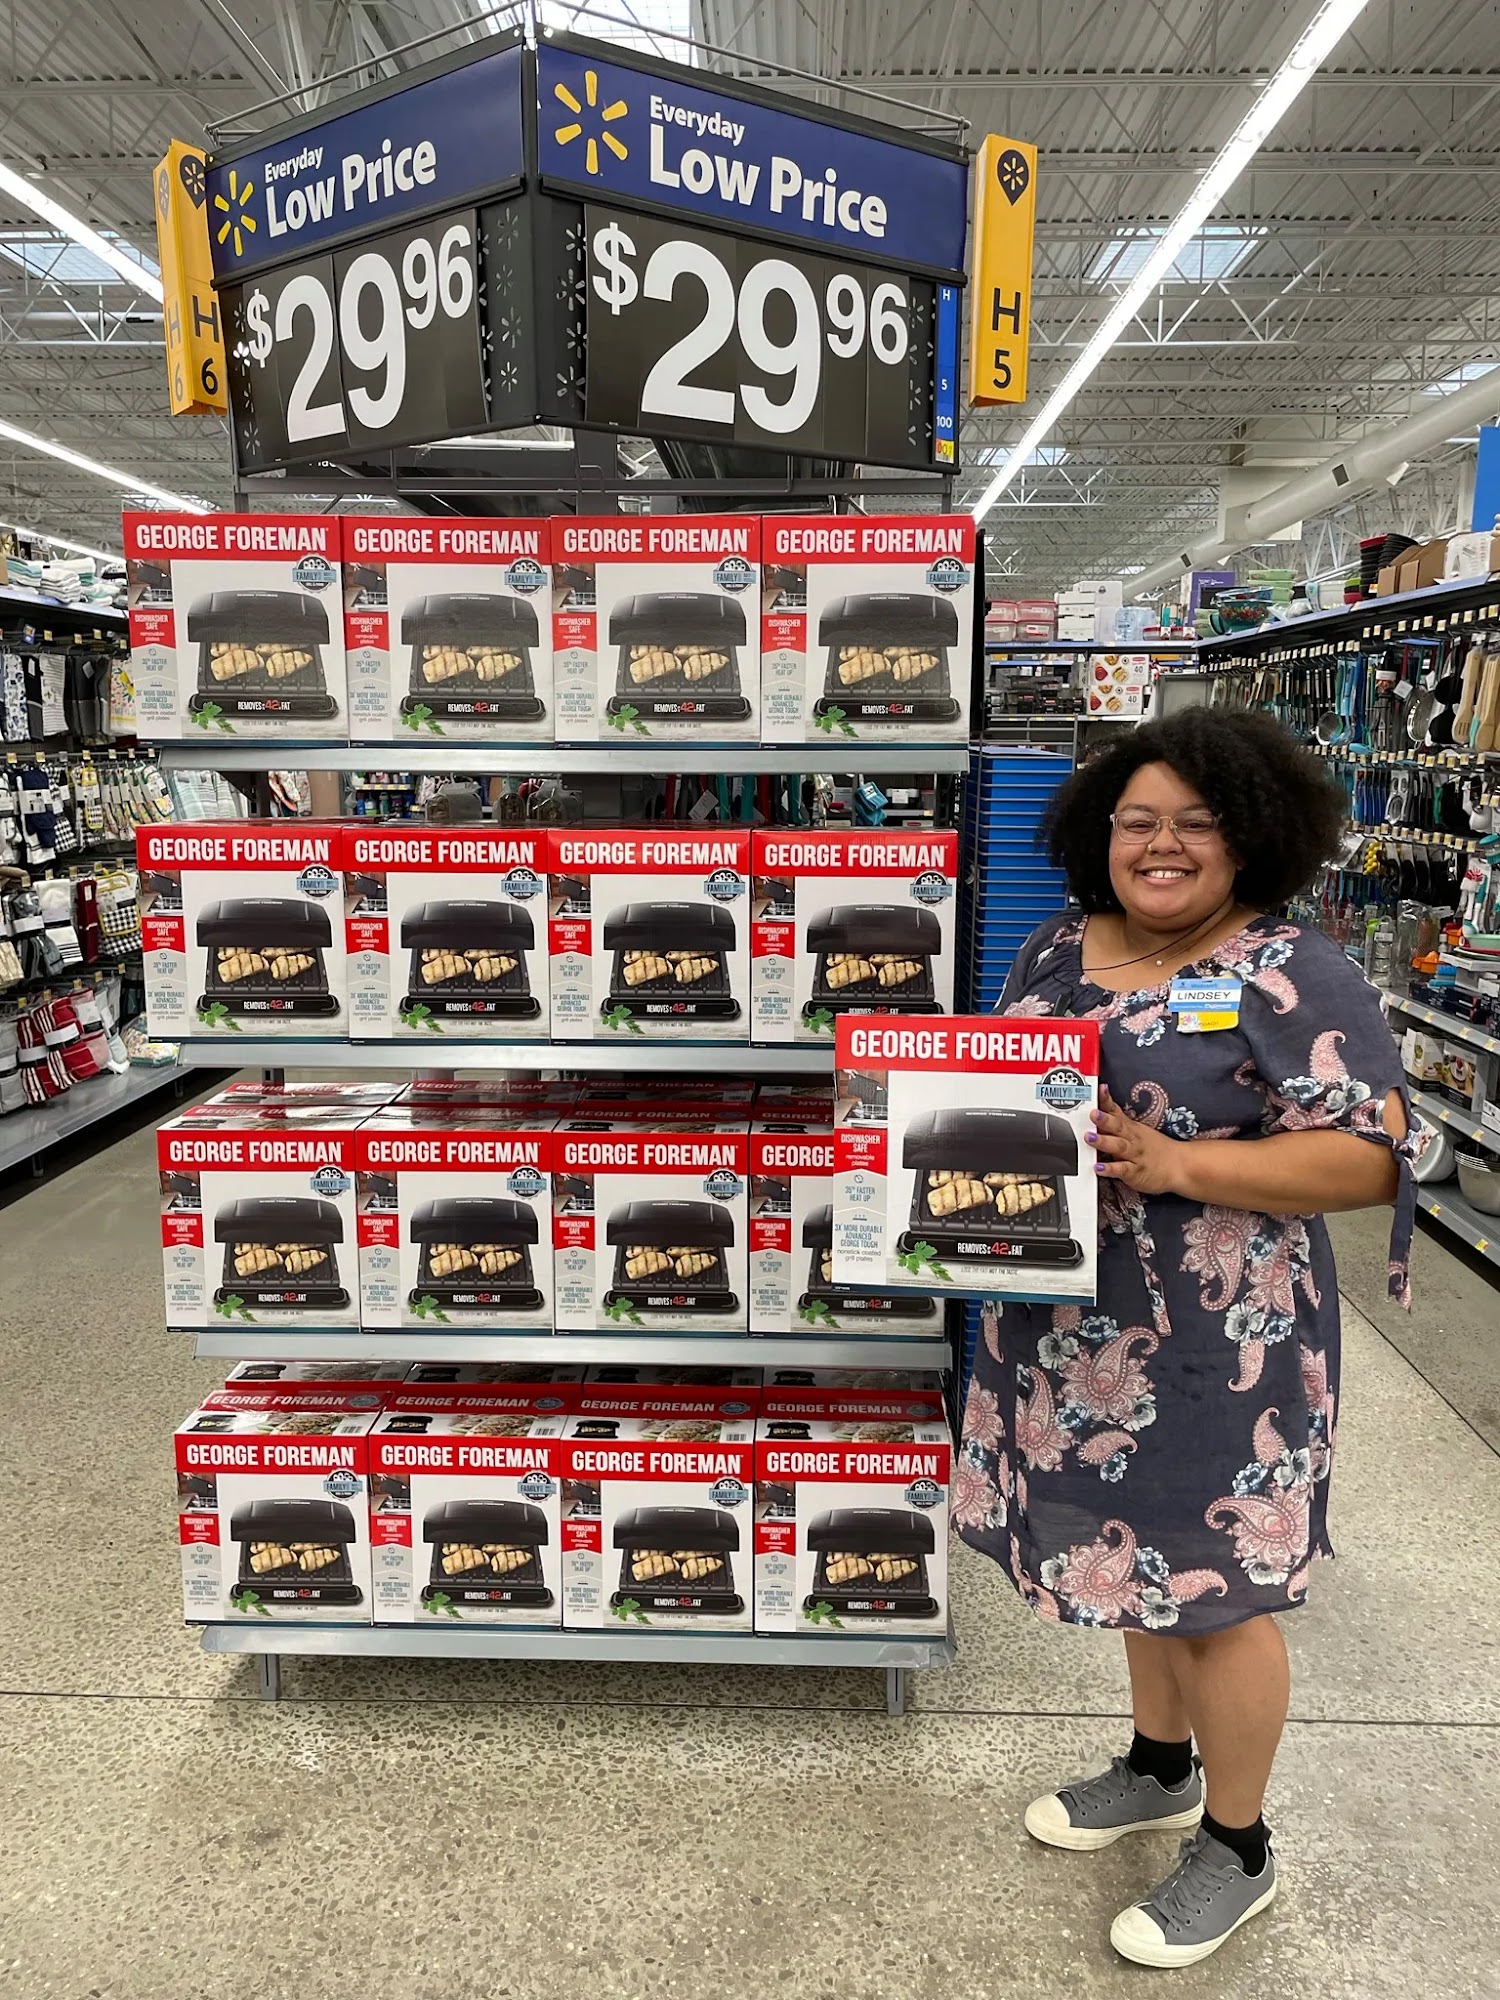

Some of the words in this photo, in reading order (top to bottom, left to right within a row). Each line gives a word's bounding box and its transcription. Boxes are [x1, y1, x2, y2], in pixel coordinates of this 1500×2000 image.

[650, 95, 745, 147] Everyday
[264, 146, 324, 184] Everyday
[265, 175, 336, 238] Low
[341, 138, 438, 211] Price
[650, 123, 761, 206] Low
[769, 155, 888, 239] Price
[942, 289, 951, 301] H
[191, 294, 220, 344] H
[992, 288, 1021, 335] H
[201, 357, 219, 396] 6
[993, 349, 1012, 389] 5
[941, 379, 947, 391] 5
[936, 416, 952, 429] 100
[135, 525, 218, 550] GEORGE
[224, 527, 327, 551] FOREMAN
[353, 529, 433, 553] GEORGE
[439, 530, 539, 554] FOREMAN
[563, 529, 642, 552] GEORGE
[649, 529, 748, 552] FOREMAN
[776, 530, 855, 554] GEORGE
[862, 530, 963, 552] FOREMAN
[296, 571, 318, 580] FAMILY
[508, 575, 529, 583] FAMILY
[716, 573, 738, 582] FAMILY
[929, 573, 951, 582] FAMILY
[148, 839, 226, 861] GEORGE
[232, 840, 329, 861] FOREMAN
[354, 840, 432, 863] GEORGE
[438, 842, 534, 863] FOREMAN
[559, 842, 636, 864] GEORGE
[642, 843, 737, 864] FOREMAN
[765, 844, 841, 867] GEORGE
[848, 845, 945, 867] FOREMAN
[300, 880, 321, 888] FAMILY
[504, 883, 525, 891] FAMILY
[707, 884, 728, 892] FAMILY
[913, 887, 934, 895] FAMILY
[1177, 991, 1231, 1000] LINDSEY
[850, 1029, 947, 1060] GEORGE
[955, 1032, 1081, 1062] FOREMAN
[1040, 1086, 1068, 1098] FAMILY
[575, 1110, 634, 1118] GEORGE
[841, 1134, 880, 1144] DISHWASHER
[852, 1143, 868, 1153] SAFE
[169, 1141, 243, 1162] GEORGE
[249, 1142, 342, 1162] FOREMAN
[367, 1141, 441, 1162] GEORGE
[446, 1142, 539, 1162] FOREMAN
[565, 1143, 638, 1165] GEORGE
[644, 1145, 735, 1165] FOREMAN
[762, 1145, 834, 1167] GEORGE
[957, 1242, 988, 1254] REMOVES
[1011, 1245, 1024, 1256] FAT
[210, 1395, 269, 1406] GEORGE
[271, 1395, 346, 1406] FOREMAN
[395, 1396, 455, 1406] GEORGE
[457, 1397, 530, 1408] FOREMAN
[580, 1399, 639, 1411] GEORGE
[642, 1401, 715, 1412] FOREMAN
[766, 1403, 825, 1413] GEORGE
[829, 1404, 902, 1414] FOREMAN
[186, 1445, 258, 1465] GEORGE
[263, 1446, 354, 1466] FOREMAN
[381, 1445, 453, 1466] GEORGE
[458, 1447, 549, 1468] FOREMAN
[571, 1451, 644, 1472] GEORGE
[650, 1453, 741, 1474] FOREMAN
[766, 1452, 839, 1473] GEORGE
[845, 1454, 937, 1475] FOREMAN
